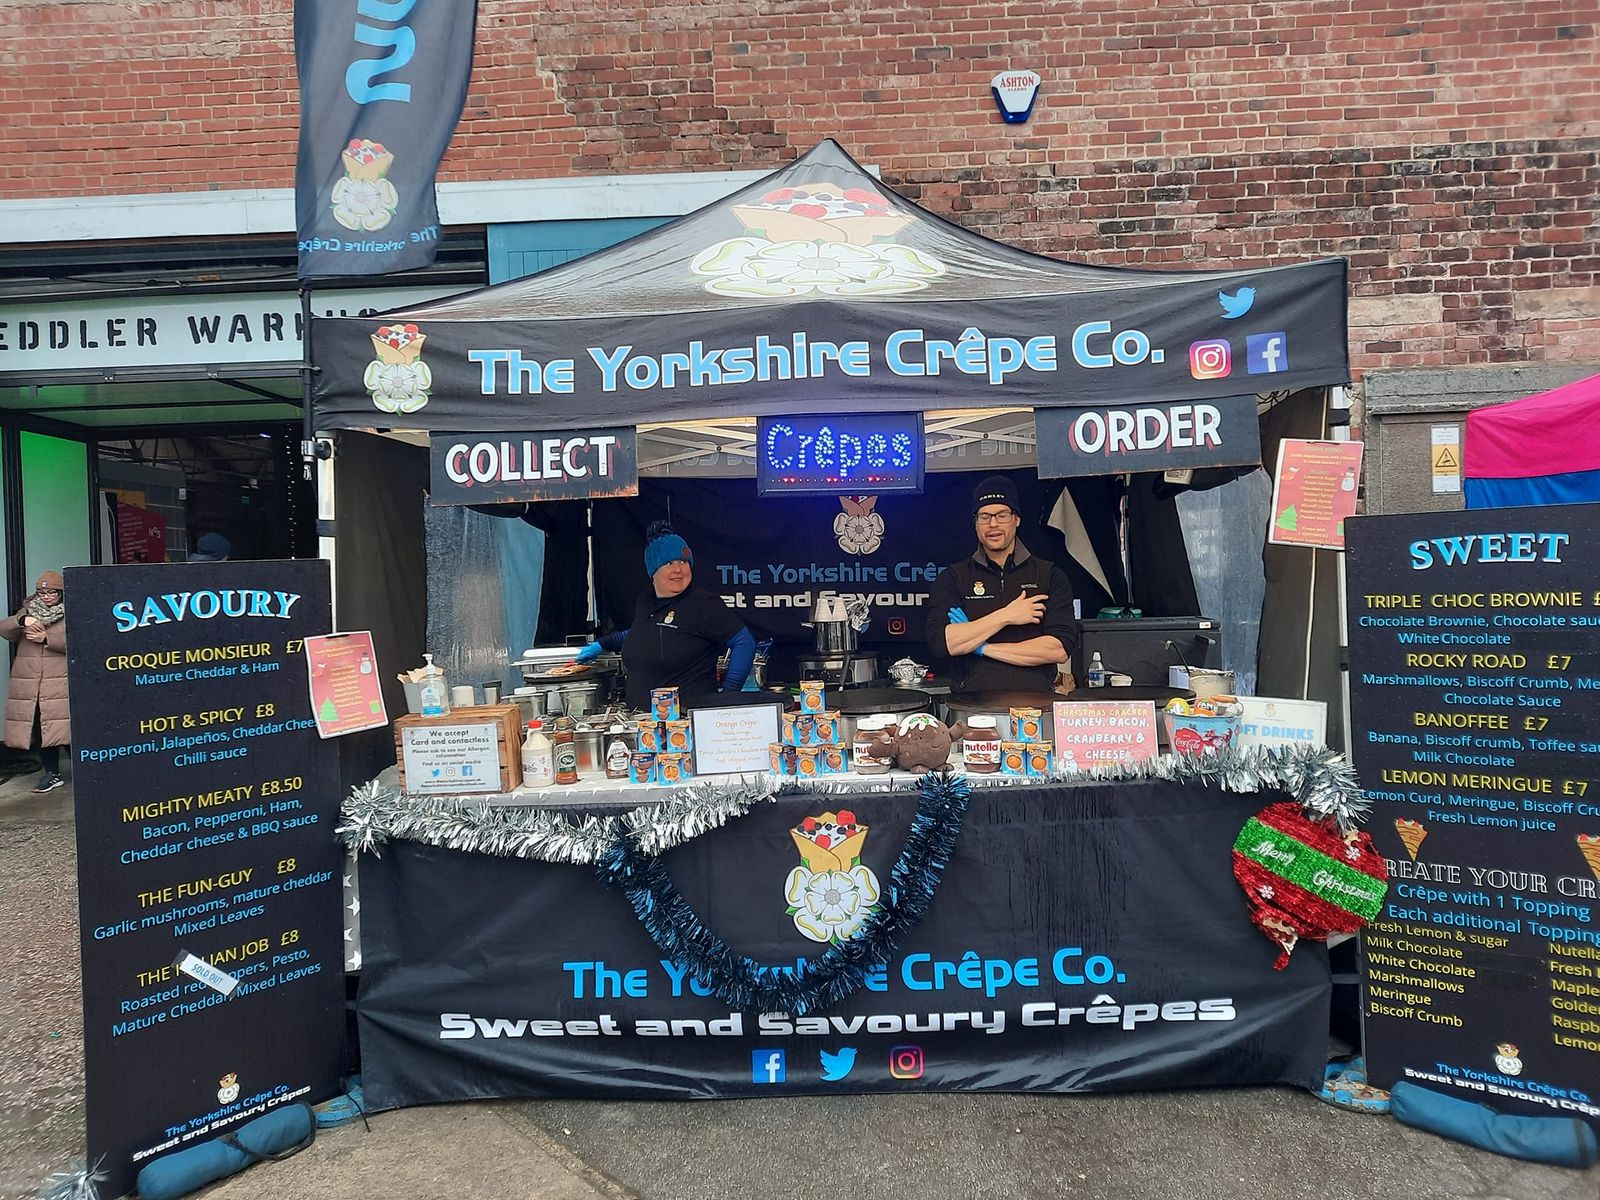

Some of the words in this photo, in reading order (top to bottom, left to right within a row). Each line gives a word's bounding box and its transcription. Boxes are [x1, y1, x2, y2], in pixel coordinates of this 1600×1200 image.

[1000, 76, 1034, 87] ASHTON
[467, 349, 575, 395] The
[586, 331, 871, 392] Yorkshire
[885, 327, 1057, 386] Crêpe
[1071, 320, 1166, 369] Co.
[1073, 404, 1223, 455] ORDER
[444, 434, 617, 485] COLLECT
[767, 423, 912, 478] Crêpes
[1409, 532, 1570, 570] SWEET
[716, 564, 762, 585] The
[767, 562, 888, 584] Yorkshire
[112, 588, 301, 634] SAVOURY
[754, 591, 812, 608] and
[1364, 594, 1422, 608] TRIPLE
[1431, 593, 1485, 608] CHOC
[1490, 592, 1583, 607] BROWNIE
[1359, 615, 1425, 627] Chocolate
[1428, 616, 1489, 628] Brownie,
[1493, 615, 1566, 627] Chocolate
[1398, 632, 1441, 645] White
[1441, 633, 1512, 645] Chocolate
[105, 650, 181, 671] CROQUE
[185, 642, 271, 664] MONSIEUR
[286, 640, 303, 654] £7
[1407, 653, 1467, 669] ROCKY
[1471, 654, 1527, 669] ROAD
[1547, 655, 1572, 670] £7
[135, 670, 182, 686] Mature
[185, 664, 238, 681] Cheddar
[252, 662, 280, 673] Ham
[1362, 673, 1464, 688] Marshmallows,
[1467, 675, 1516, 688] Biscoff
[1518, 676, 1573, 690] Crumb,
[1057, 708, 1106, 718] CHRISTMAS
[1109, 708, 1149, 717] CRACKER
[1443, 693, 1514, 707] Chocolate
[1518, 695, 1562, 708] Sauce
[140, 715, 178, 735] HOT
[181, 714, 196, 728] &
[199, 707, 244, 726] SPICY
[256, 703, 275, 719] £8
[1241, 723, 1259, 736] FT
[1261, 725, 1314, 740] DRINKS
[1414, 712, 1510, 730] BANOFFEE
[1523, 716, 1549, 732] £7
[80, 740, 159, 763] Pepperoni,
[160, 729, 231, 751] Jalapeños,
[232, 720, 284, 740] Cheddar
[444, 729, 469, 737] accept
[448, 736, 489, 745] contactless
[1066, 733, 1132, 744] CRANBERRY
[1136, 732, 1145, 743] &
[1368, 731, 1422, 746] Banana,
[1425, 734, 1472, 747] Biscoff
[1475, 736, 1524, 751] crumb,
[1529, 739, 1576, 752] Toffee
[174, 750, 206, 768] Chilli
[210, 745, 247, 763] sauce
[965, 742, 999, 752] nutella
[1085, 749, 1126, 760] CHEESE
[1413, 751, 1442, 764] Milk
[1445, 752, 1515, 767] Chocolate
[1382, 769, 1447, 786] LEMON
[1452, 774, 1553, 794] MERINGUE
[1562, 780, 1589, 797] £7
[122, 796, 193, 823] MIGHTY
[198, 785, 254, 809] MEATY
[260, 776, 302, 797] £8.50
[1361, 790, 1406, 802] Lemon
[1408, 791, 1445, 805] Curd,
[1450, 795, 1519, 812] Meringue,
[1524, 800, 1574, 814] Biscoff
[142, 820, 191, 840] Bacon,
[194, 804, 267, 831] Pepperoni,
[269, 797, 303, 814] Ham,
[1428, 810, 1466, 824] Fresh
[1470, 814, 1518, 828] Lemon
[1521, 817, 1557, 832] juice
[120, 841, 183, 865] Cheddar
[186, 832, 234, 851] cheese
[251, 820, 280, 838] BBQ
[282, 813, 319, 829] sauce
[137, 887, 173, 909] THE
[178, 868, 254, 900] FUN-GUY
[276, 858, 296, 875] £8
[1251, 840, 1296, 866] Merry
[1312, 870, 1377, 901] Christmas
[1385, 858, 1461, 885] REATE
[1468, 867, 1549, 893] YOUR
[1557, 876, 1600, 900] CR
[94, 918, 138, 940] Garlic
[141, 897, 230, 928] mushrooms,
[233, 884, 280, 904] mature
[283, 870, 334, 890] cheddar
[1396, 884, 1448, 903] Crêpe
[1452, 890, 1491, 907] with
[1497, 895, 1505, 909] 1
[1511, 896, 1592, 923] Topping
[173, 917, 216, 938] Mixed
[220, 904, 266, 926] Leaves
[1388, 905, 1428, 922] Each
[1432, 911, 1521, 934] additional
[1367, 936, 1393, 950] Milk
[1396, 940, 1464, 959] Chocolate
[1368, 920, 1403, 934] Fresh
[1406, 923, 1452, 940] Lemon
[1470, 934, 1509, 950] sugar
[136, 967, 171, 987] THE
[240, 938, 269, 961] JOB
[281, 929, 300, 946] £8
[1367, 952, 1406, 968] White
[1409, 958, 1476, 978] Chocolate
[1550, 961, 1592, 977] Fresh
[120, 986, 180, 1014] Roasted
[272, 949, 311, 969] Pesto,
[191, 963, 209, 978] SOLD
[208, 973, 224, 986] OUT
[563, 960, 648, 999] The
[901, 950, 1039, 998] Crêpe
[1052, 946, 1127, 986] Co.
[1368, 968, 1465, 994] Marshmallows
[112, 1012, 167, 1037] Mature
[236, 977, 276, 998] Mixed
[279, 962, 322, 985] Leaves
[1369, 986, 1432, 1006] Meringue
[1552, 978, 1600, 997] Maple
[439, 1012, 622, 1040] Sweet
[635, 1011, 744, 1037] and
[758, 1008, 1006, 1037] Savoury
[1021, 993, 1238, 1031] Crêpes
[1370, 1003, 1414, 1019] Biscoff
[1417, 1010, 1463, 1028] Crumb
[1404, 1068, 1452, 1085] Sweet
[1455, 1078, 1485, 1092] and
[1488, 1084, 1558, 1108] Savoury
[1436, 1063, 1459, 1076] The
[1462, 1068, 1525, 1091] Yorkshire
[1527, 1081, 1567, 1099] Crêpe
[1570, 1090, 1591, 1103] Co.
